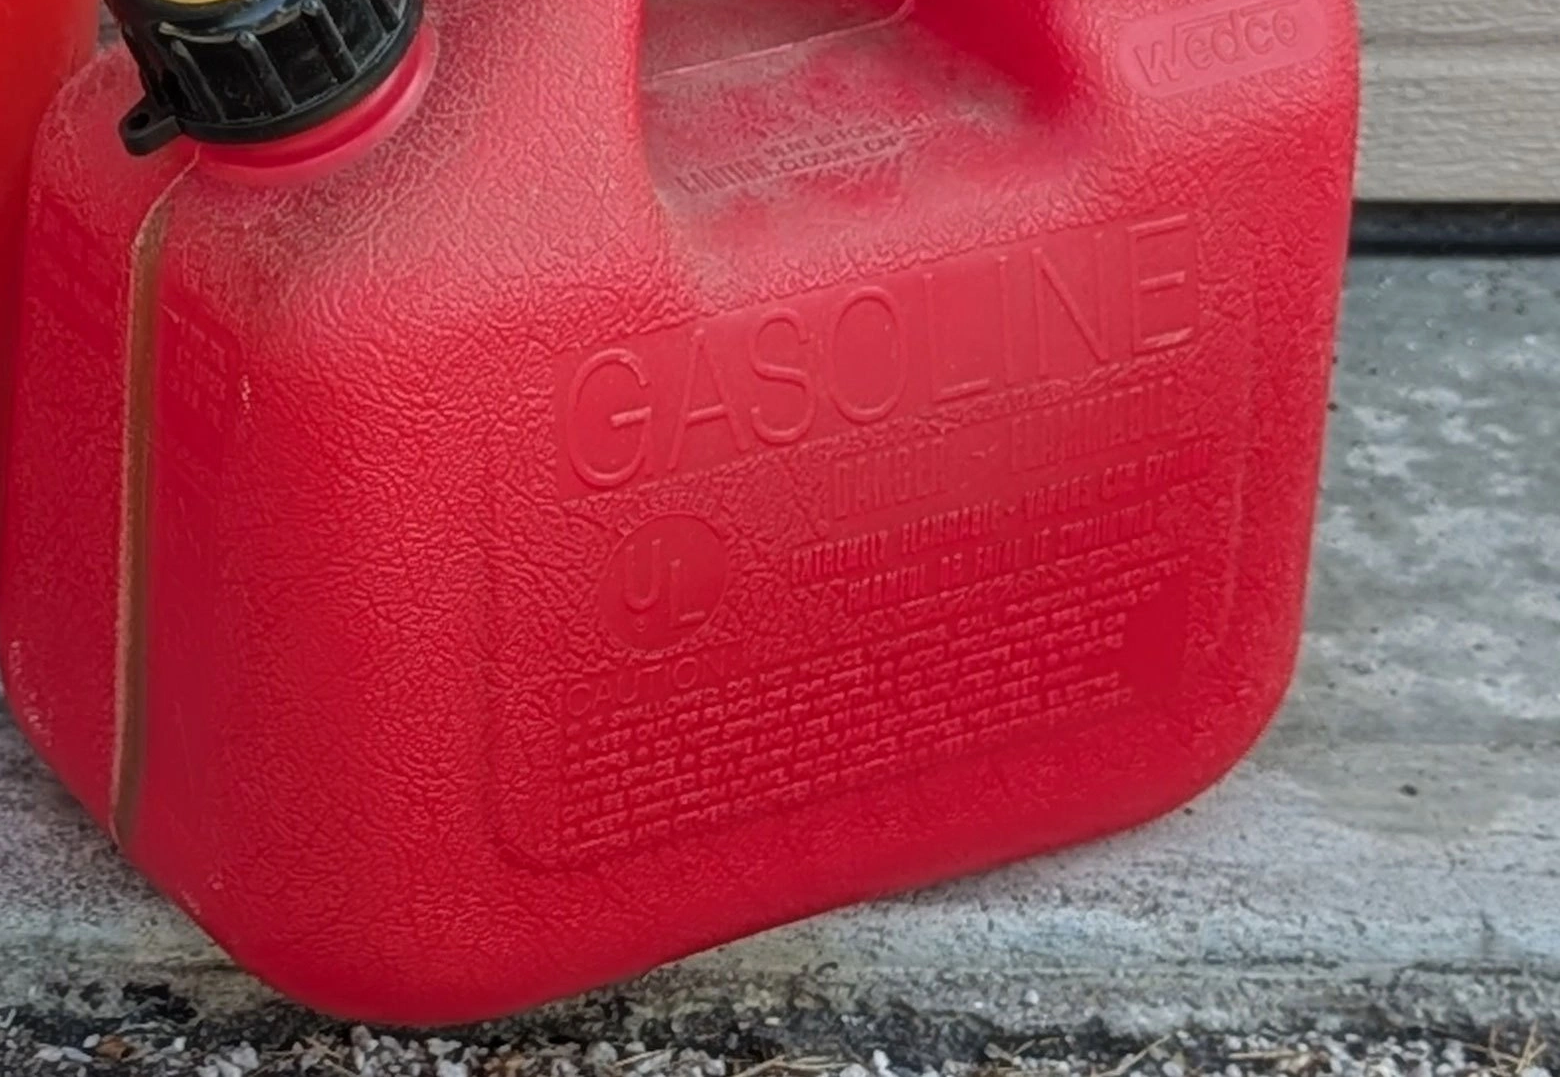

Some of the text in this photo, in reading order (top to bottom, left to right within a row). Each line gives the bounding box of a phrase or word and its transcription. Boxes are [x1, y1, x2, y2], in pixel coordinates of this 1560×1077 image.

[566, 216, 1193, 488] GASOLINE
[791, 529, 889, 584] EXTREMELY
[902, 500, 1000, 554] FLAMMABLE
[1022, 476, 1091, 521] VAPORS
